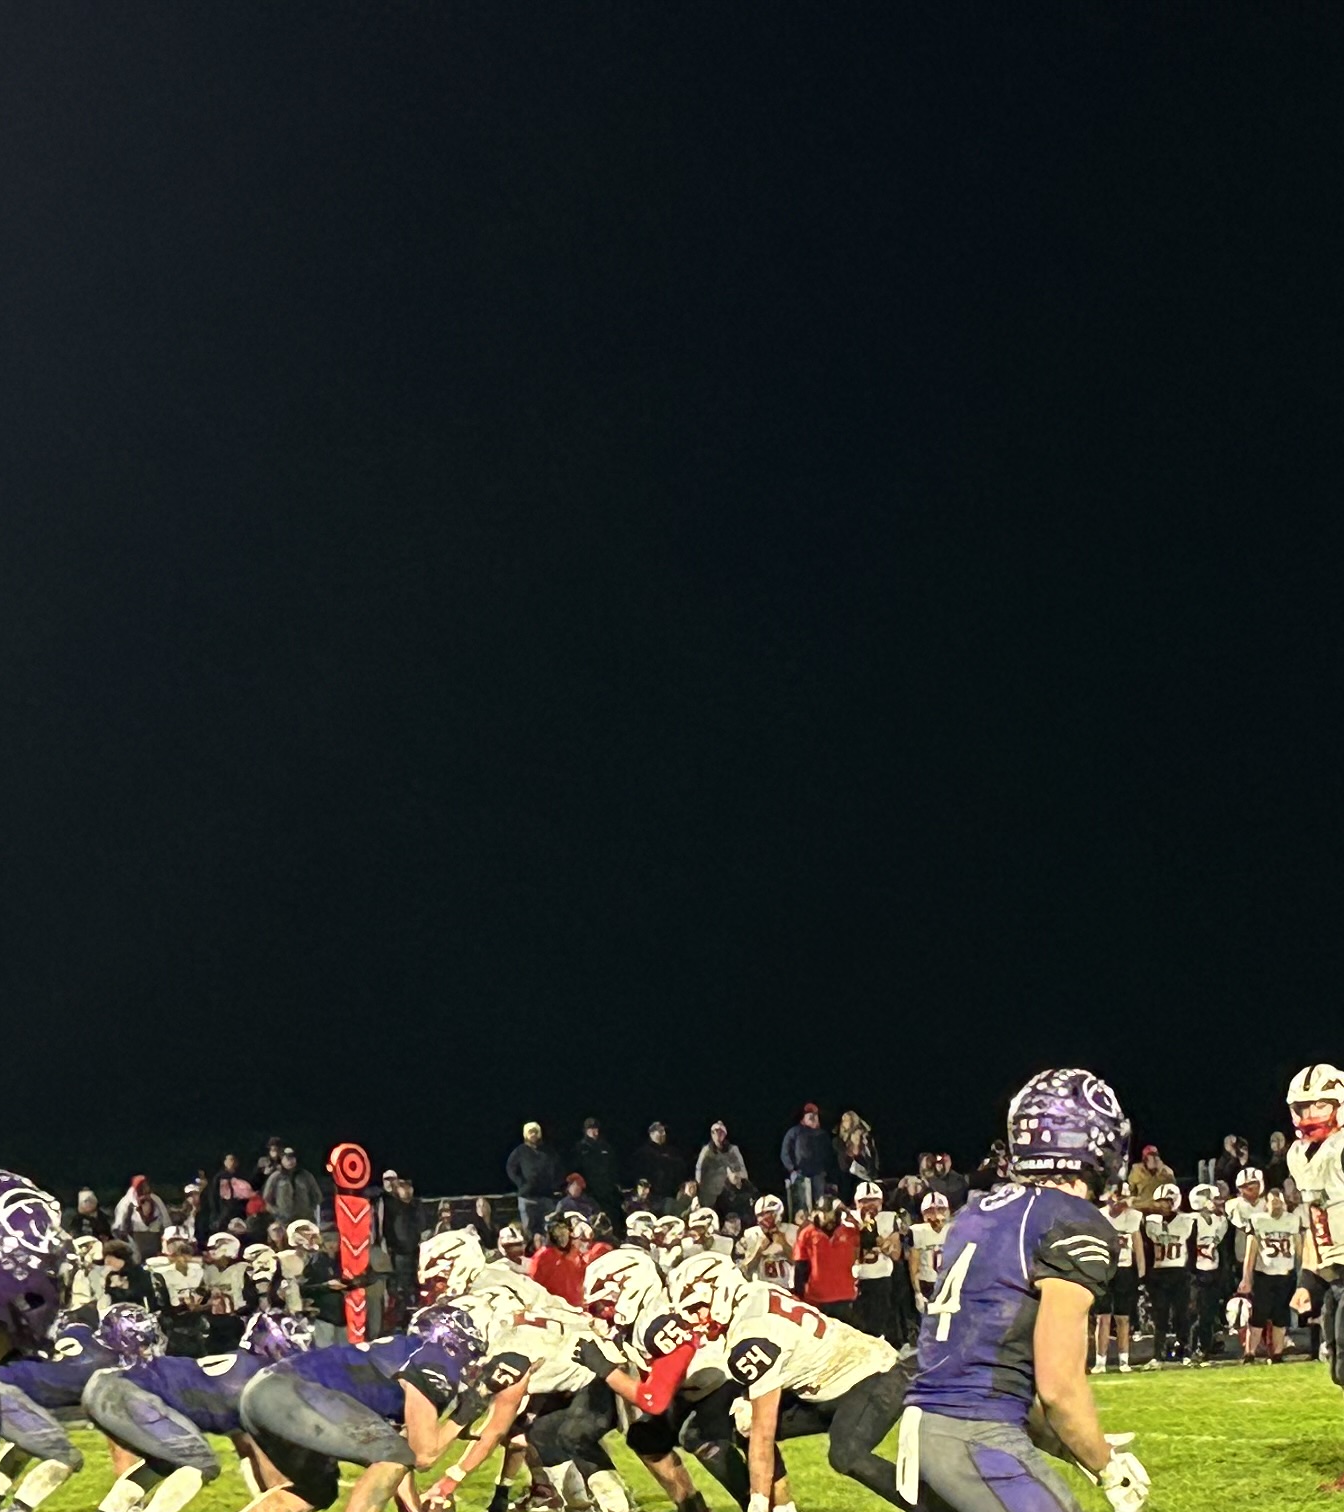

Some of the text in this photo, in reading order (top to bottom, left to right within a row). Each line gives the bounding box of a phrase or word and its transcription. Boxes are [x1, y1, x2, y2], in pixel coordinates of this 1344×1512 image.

[1265, 1238, 1291, 1258] 50
[927, 1242, 977, 1342] 4
[654, 1319, 692, 1354] 65
[492, 1362, 521, 1385] 51
[736, 1345, 772, 1380] 54
